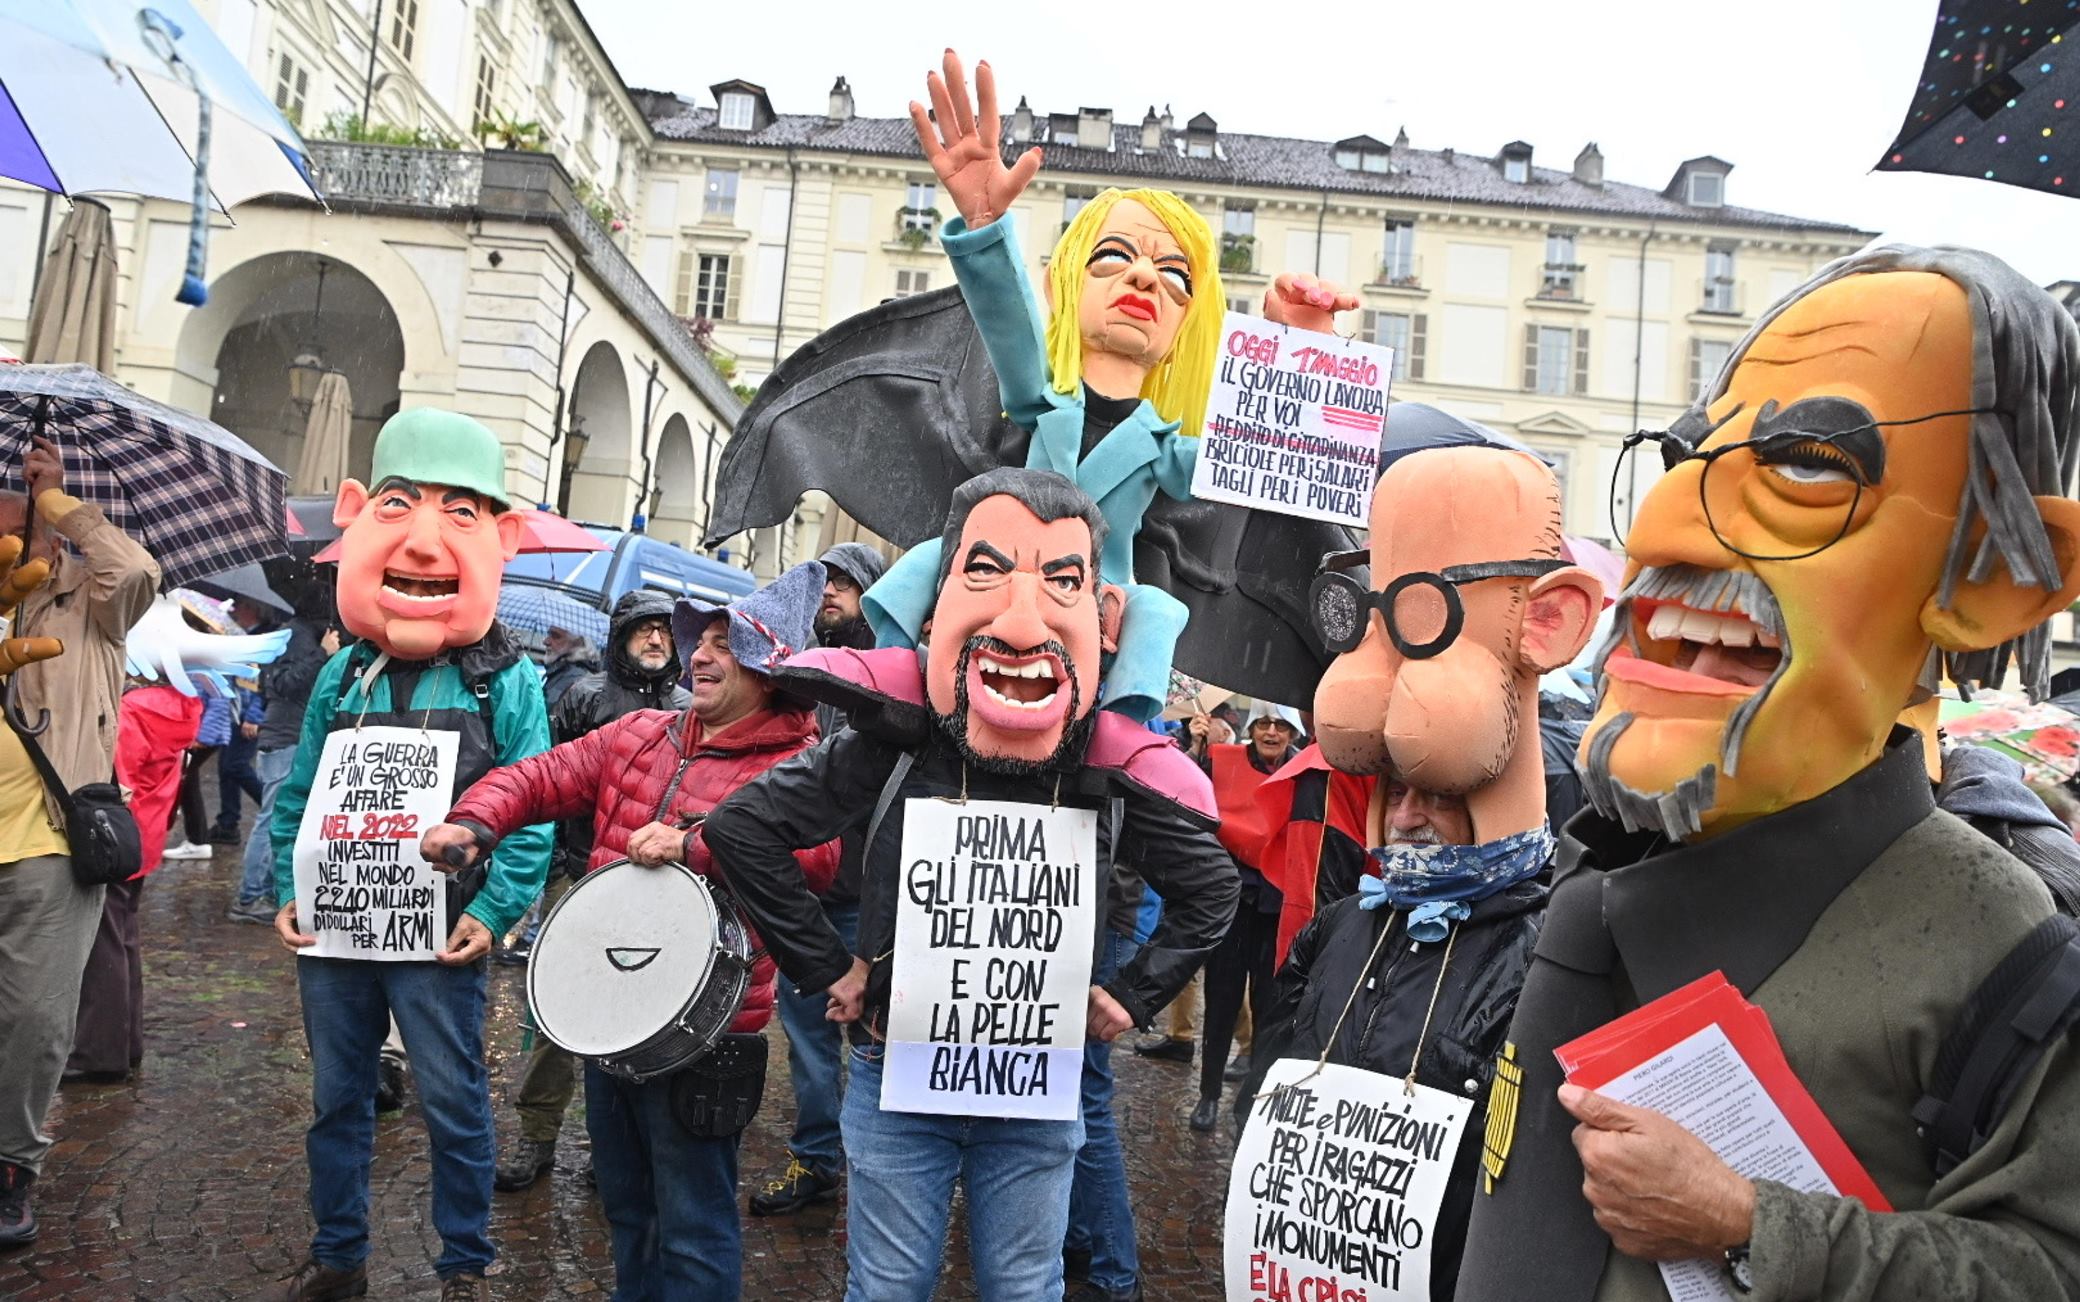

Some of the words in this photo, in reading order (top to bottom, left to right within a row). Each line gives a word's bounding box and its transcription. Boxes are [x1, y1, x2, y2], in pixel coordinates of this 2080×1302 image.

[1240, 361, 1321, 403] GOVERNO
[1324, 380, 1383, 416] LAVORA
[1236, 390, 1267, 424] PER
[340, 743, 357, 765] LA
[363, 742, 438, 769] GUERRA
[370, 767, 438, 791] GROSSO
[340, 790, 408, 812] AFFARE
[320, 815, 354, 840] NEL
[358, 812, 418, 840] 2022
[319, 862, 347, 885] NEL
[357, 864, 415, 886] MONDO
[315, 885, 370, 912] 2240
[352, 933, 379, 949] PER
[930, 908, 980, 950] DEL
[987, 907, 1063, 953] NORD
[951, 959, 971, 1000] E
[985, 958, 1048, 1002] CON
[929, 1003, 960, 1044] LA
[971, 1002, 1060, 1047] PELLE
[1268, 1127, 1308, 1175] PER
[1250, 1162, 1296, 1207] CHE
[1299, 1177, 1423, 1249] SPORCANO
